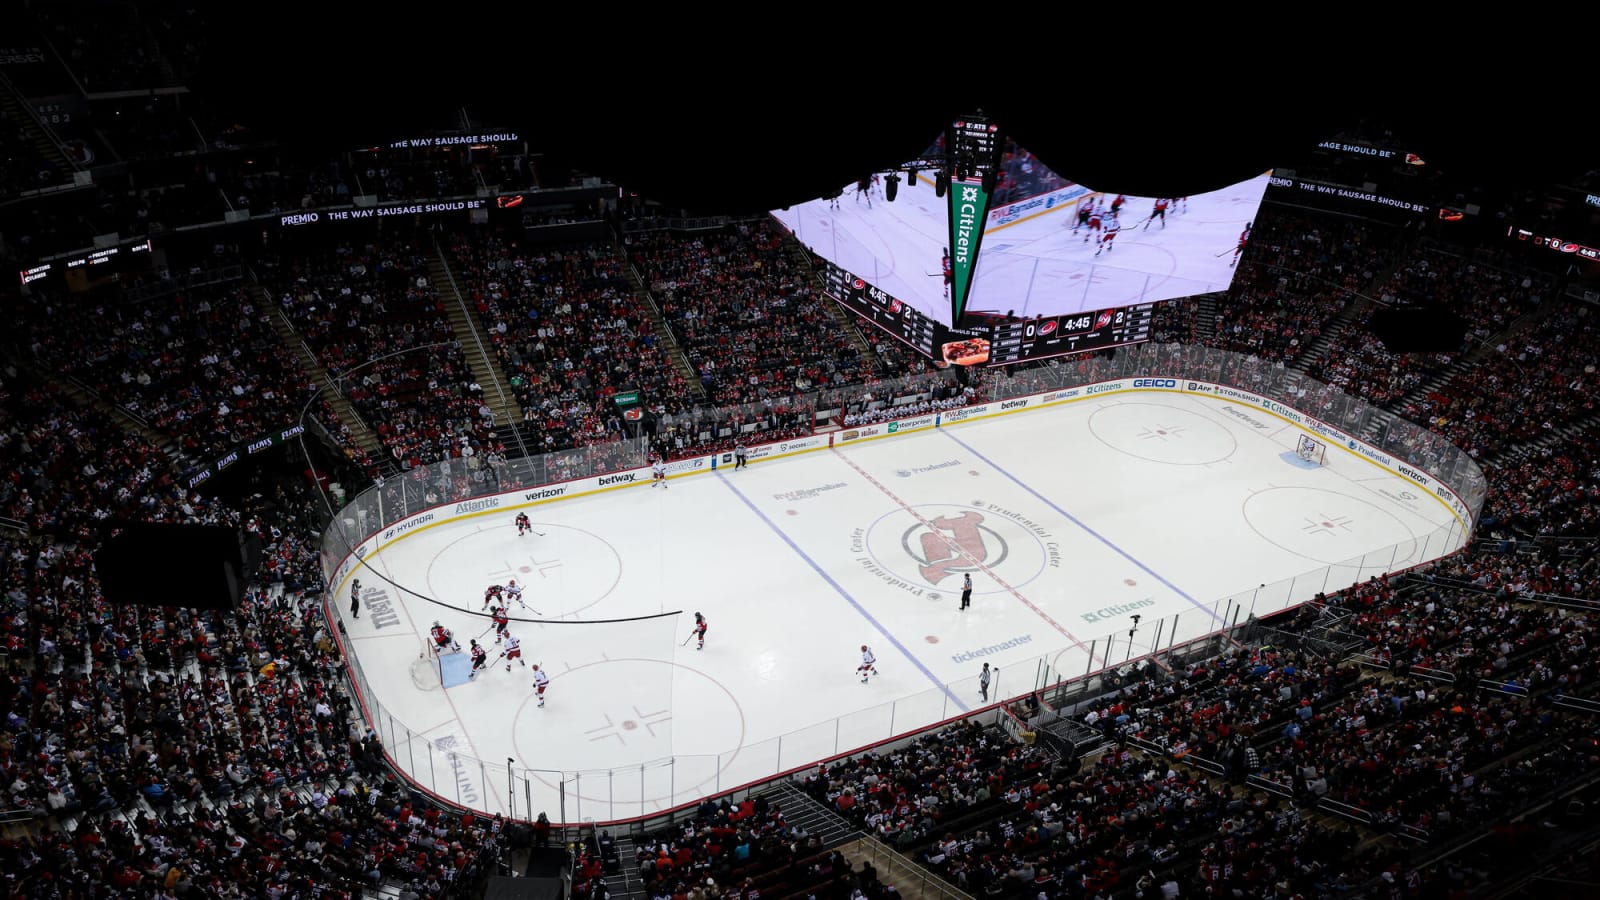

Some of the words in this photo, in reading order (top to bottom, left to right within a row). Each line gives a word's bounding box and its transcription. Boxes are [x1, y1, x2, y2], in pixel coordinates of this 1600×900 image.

[410, 138, 432, 146] WAY
[435, 135, 478, 145] SAUSAGE
[481, 133, 518, 143] SHOULD
[1342, 144, 1377, 156] SHOULD
[1268, 177, 1293, 188] REMIO
[1300, 183, 1315, 192] THE
[1317, 185, 1337, 195] WAY
[1338, 189, 1377, 202] SAUSAGE
[1378, 197, 1411, 210] SHOULD
[281, 212, 319, 225] PREMIO
[328, 211, 348, 220] THE
[351, 209, 374, 219] WAY
[377, 205, 423, 216] SAUSAGE
[425, 202, 465, 213] SHOULD
[957, 203, 976, 263] Citizens
[845, 272, 851, 283] 0
[869, 286, 887, 304] 4:45
[904, 306, 911, 319] 2
[1026, 325, 1034, 337] 0
[1065, 316, 1091, 331] 4:45
[1115, 311, 1124, 323] 2
[1094, 382, 1122, 393] Citizens
[1133, 379, 1176, 388] GEICO
[1001, 399, 1028, 410] betway
[1271, 403, 1301, 423] Citizens
[1358, 446, 1391, 466] Prudential
[598, 472, 636, 486] betway
[1398, 464, 1428, 486] verizon
[525, 487, 564, 501] verizon
[455, 497, 499, 515] Atlantic
[397, 513, 434, 533] HYUNDAI
[850, 527, 865, 553] Center
[987, 503, 1052, 538] Prudential
[1046, 542, 1062, 569] Center
[855, 557, 924, 596] Prudential
[1098, 597, 1156, 620] Citizens
[951, 634, 1033, 664] ticketmaster
